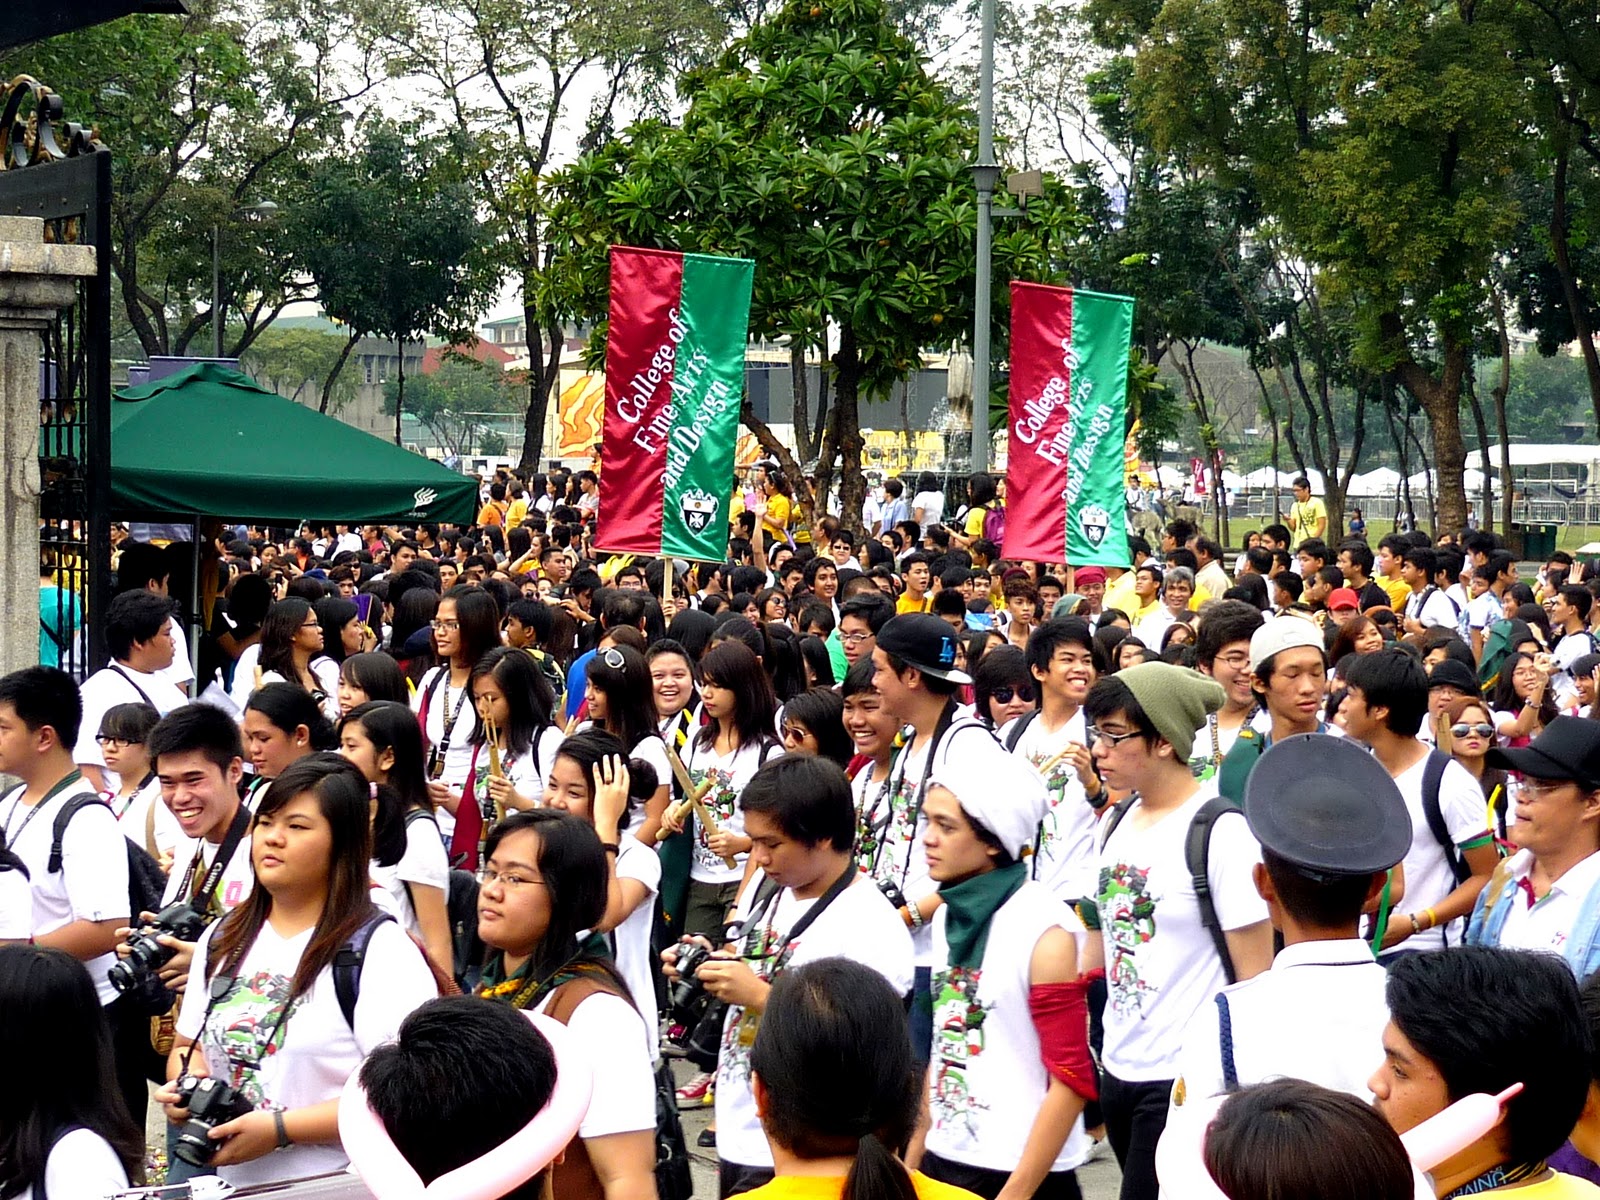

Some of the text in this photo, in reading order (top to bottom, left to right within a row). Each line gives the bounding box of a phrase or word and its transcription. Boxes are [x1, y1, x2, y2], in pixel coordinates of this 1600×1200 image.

[616, 308, 689, 424] College of
[633, 347, 708, 455] Fine Arts
[1015, 338, 1081, 444] College of
[660, 381, 730, 490] and Design
[1035, 377, 1093, 467] Fine Arts
[1061, 404, 1114, 505] and Design
